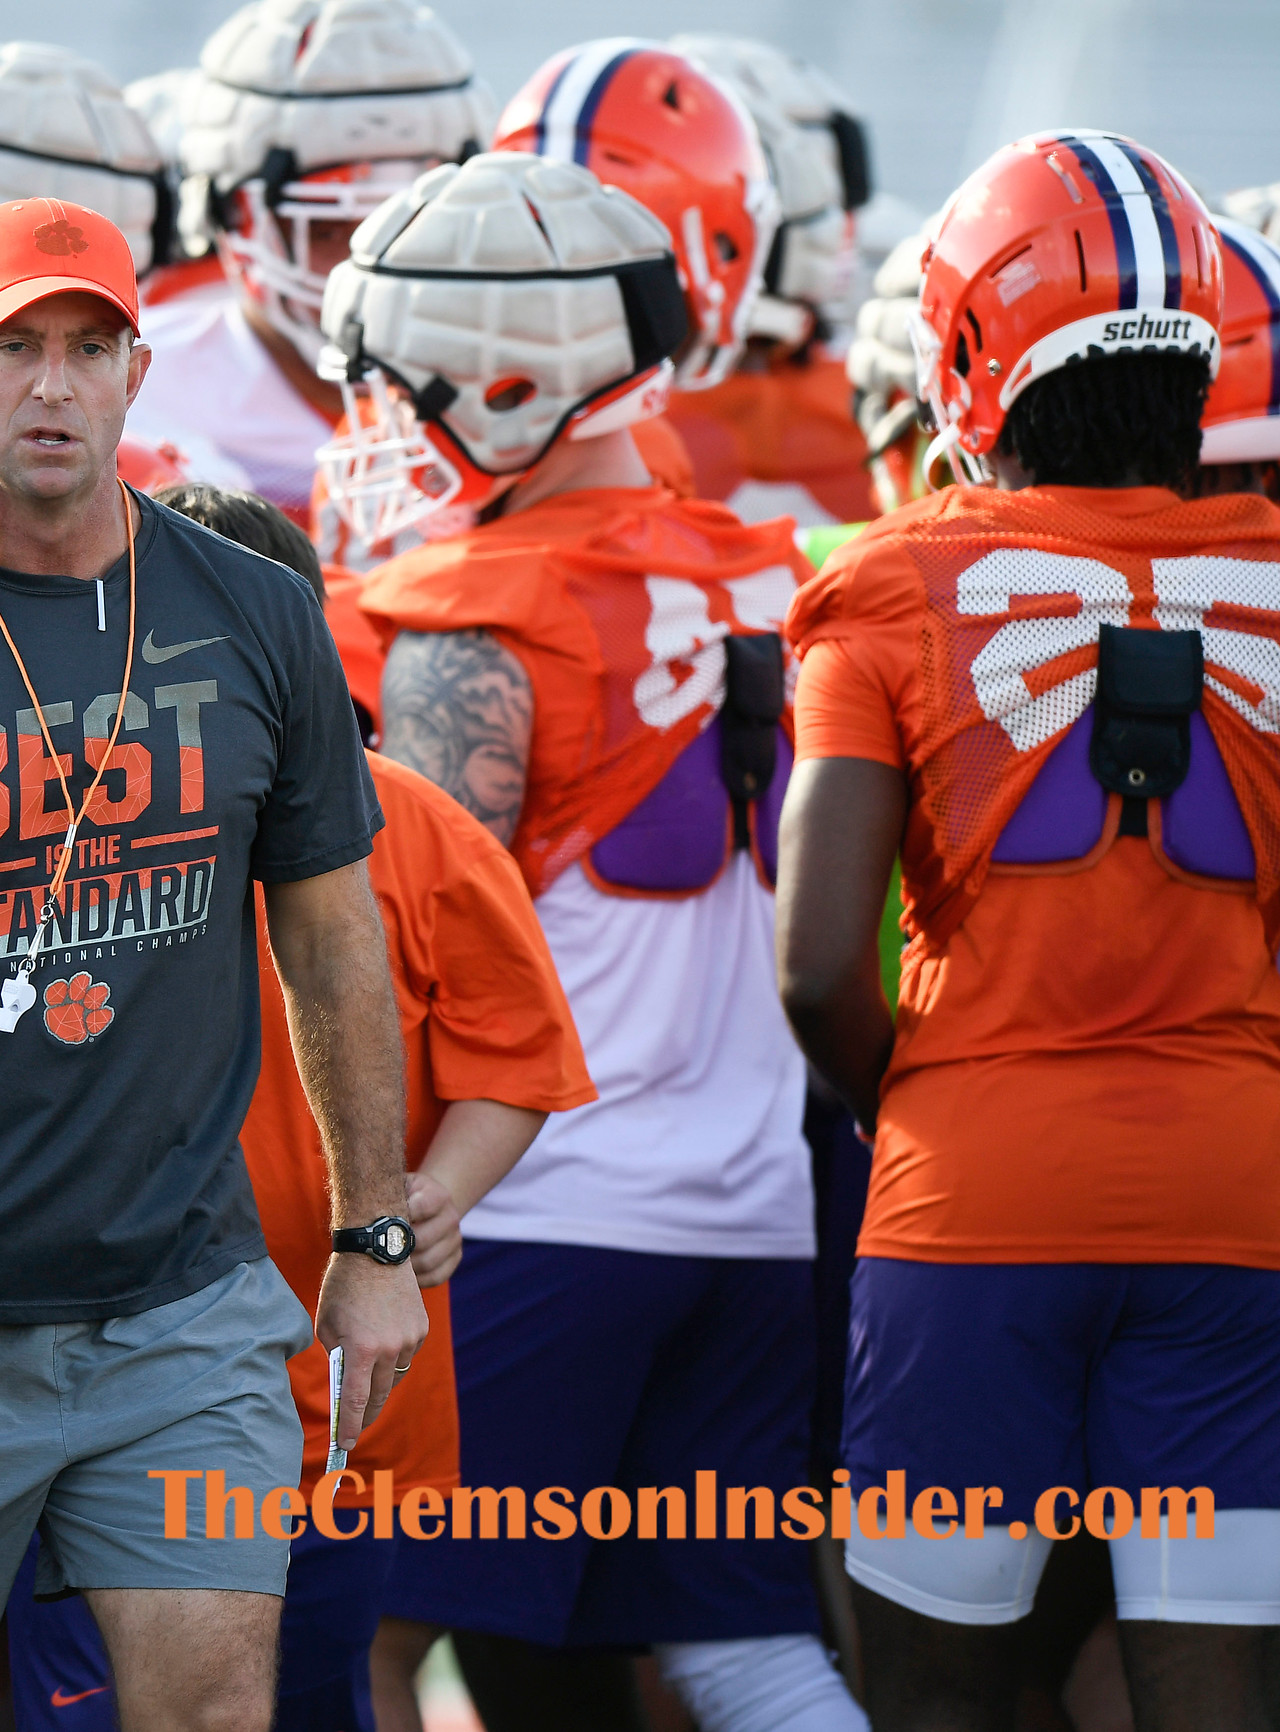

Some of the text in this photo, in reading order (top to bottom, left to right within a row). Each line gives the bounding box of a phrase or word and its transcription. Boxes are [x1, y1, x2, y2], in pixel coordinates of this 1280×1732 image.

[1102, 313, 1192, 342] schutt
[75, 834, 121, 870] THE
[10, 945, 117, 973] NATIONAL
[136, 924, 207, 952] CHAMPS
